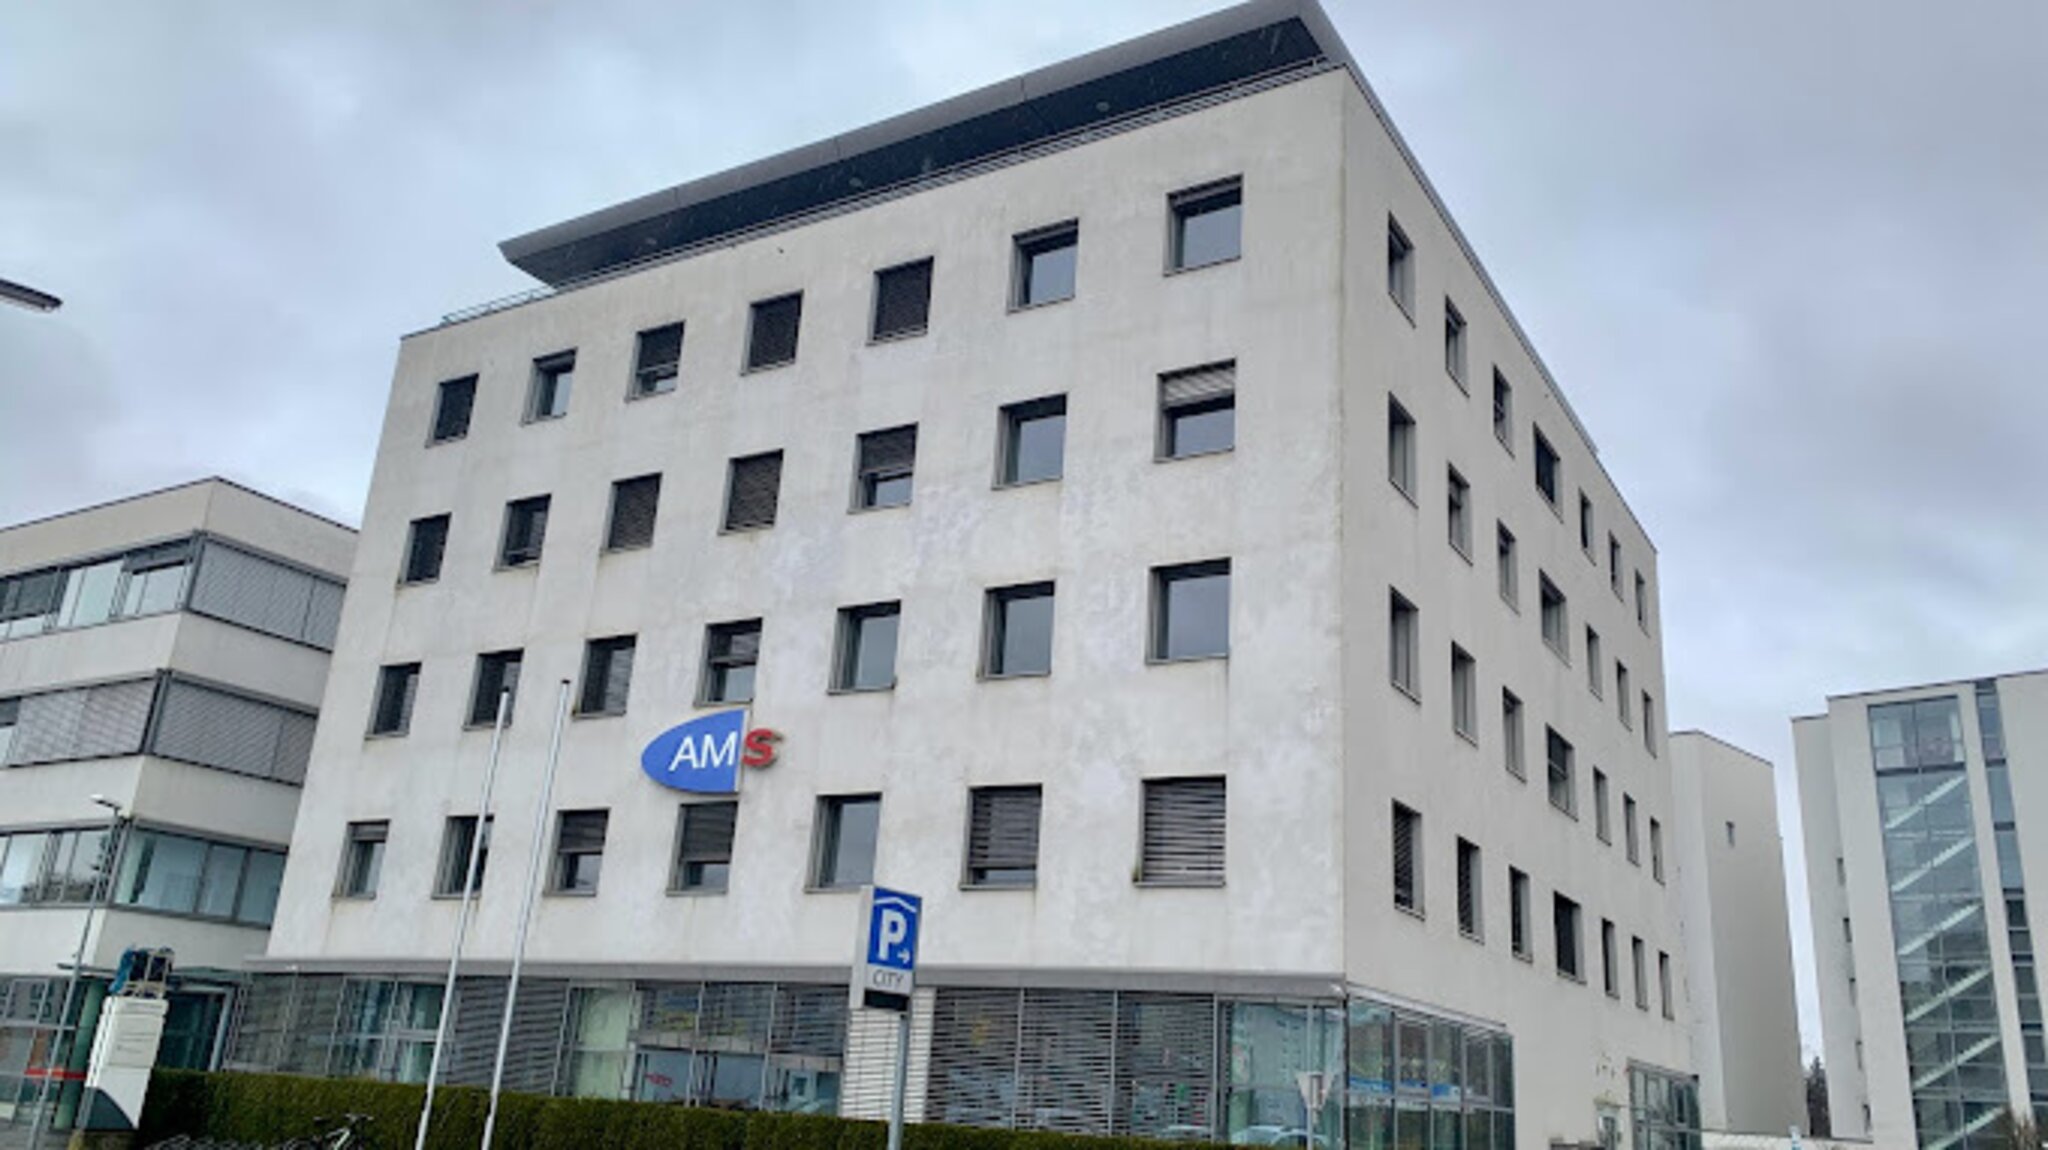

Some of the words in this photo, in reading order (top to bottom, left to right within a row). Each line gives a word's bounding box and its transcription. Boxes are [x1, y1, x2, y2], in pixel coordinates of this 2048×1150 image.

[668, 728, 778, 772] AMS
[878, 908, 907, 961] P
[873, 969, 905, 988] CITY
